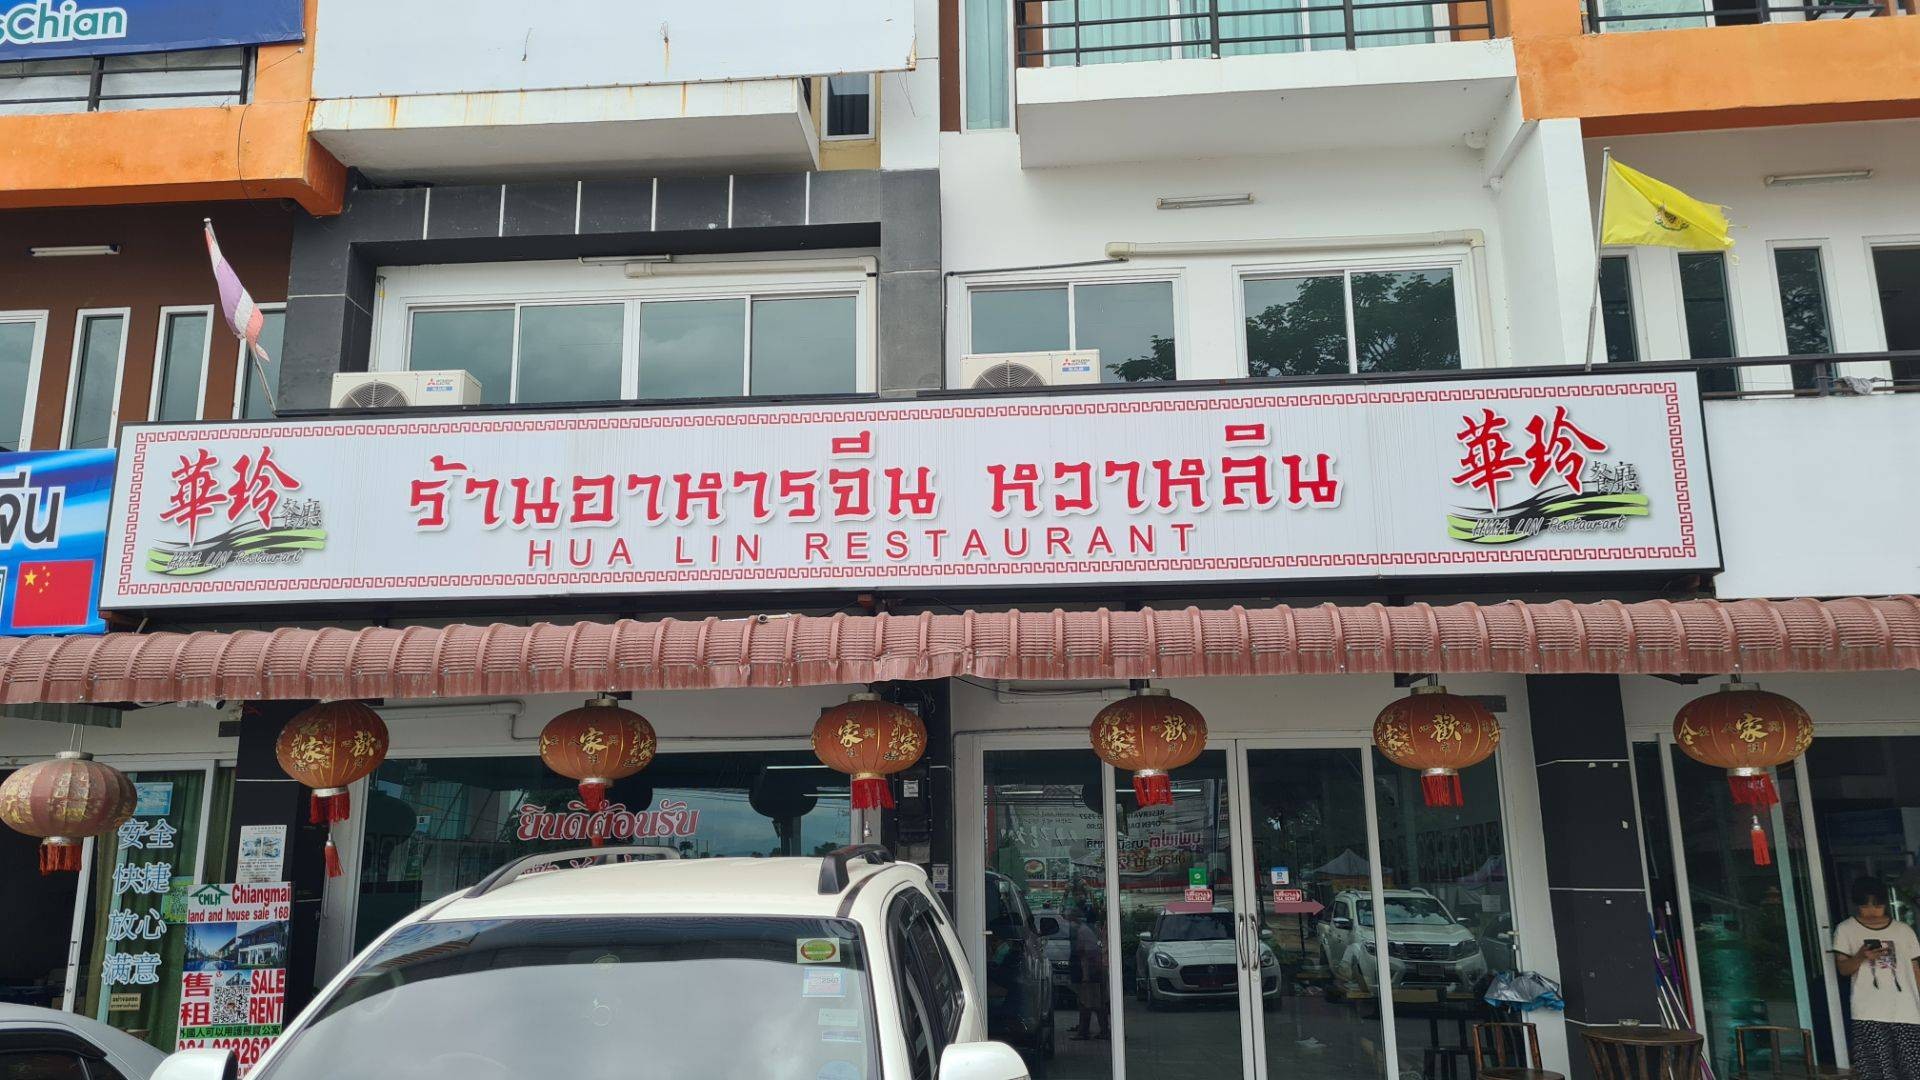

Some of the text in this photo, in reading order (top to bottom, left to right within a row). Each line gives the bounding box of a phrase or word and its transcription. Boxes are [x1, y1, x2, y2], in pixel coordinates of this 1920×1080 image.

[411, 424, 1338, 526] ร้านอาหารจีน หวาหลิน
[1451, 405, 1607, 515] 華玲
[159, 446, 301, 548] 華玲
[527, 522, 1195, 567] HUA LIN RESTAURANT
[117, 818, 178, 851] 安全
[112, 862, 171, 895] 快捷
[231, 882, 291, 907] Chiangmai
[106, 907, 167, 942] 放心
[187, 906, 289, 922] land and house sale 168
[101, 952, 162, 986] 满意
[183, 972, 213, 998] 售
[251, 969, 286, 995] SALE
[180, 1001, 212, 1027] 租
[249, 997, 285, 1025] RENT
